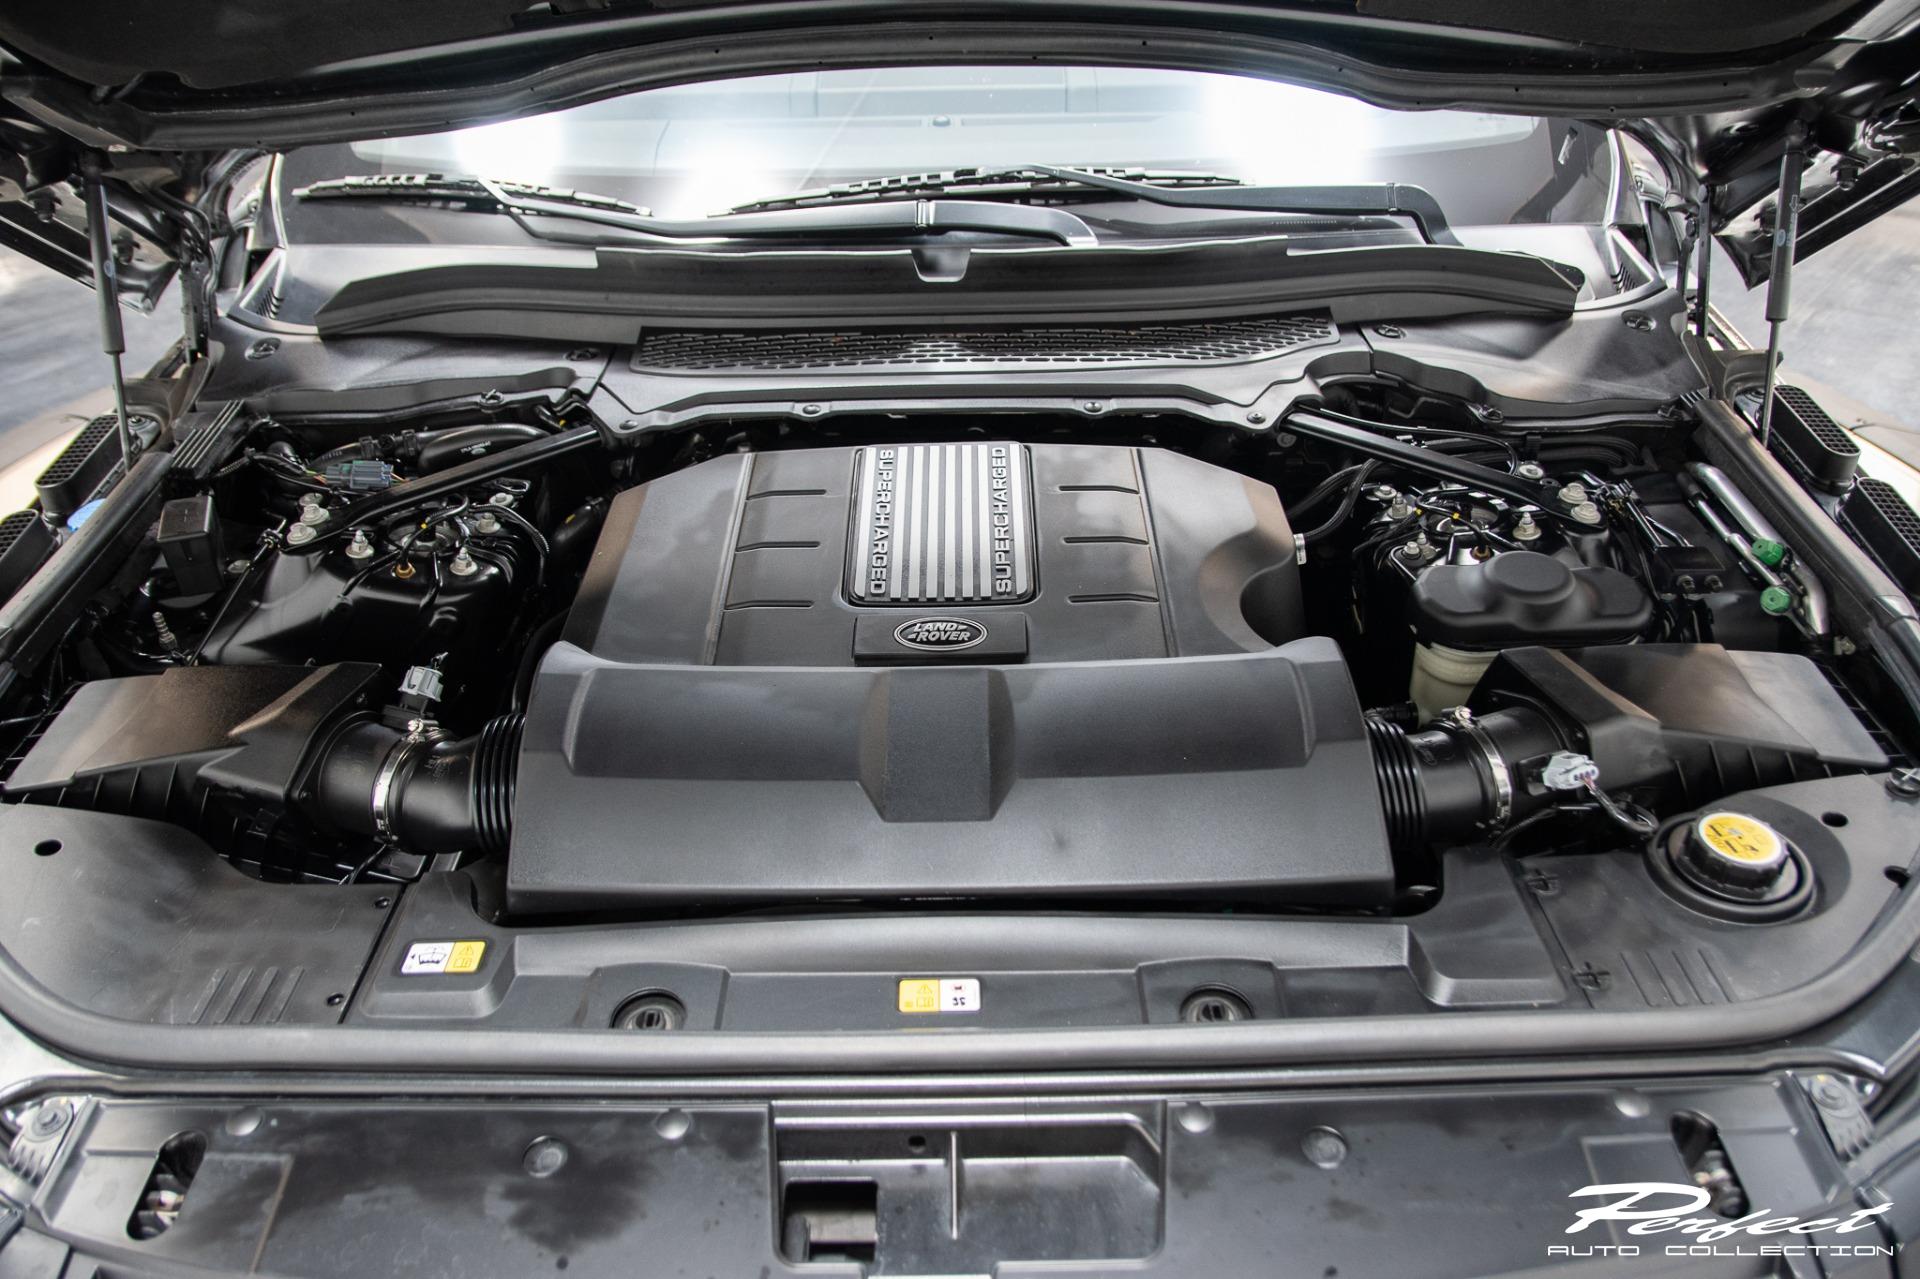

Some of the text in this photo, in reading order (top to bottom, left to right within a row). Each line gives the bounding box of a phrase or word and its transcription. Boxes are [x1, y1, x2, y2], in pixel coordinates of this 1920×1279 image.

[870, 449, 894, 595] SUPERCHARGED
[991, 447, 1012, 593] SUPERCHARGED
[913, 622, 958, 632] LAND
[916, 631, 971, 642] ROVER
